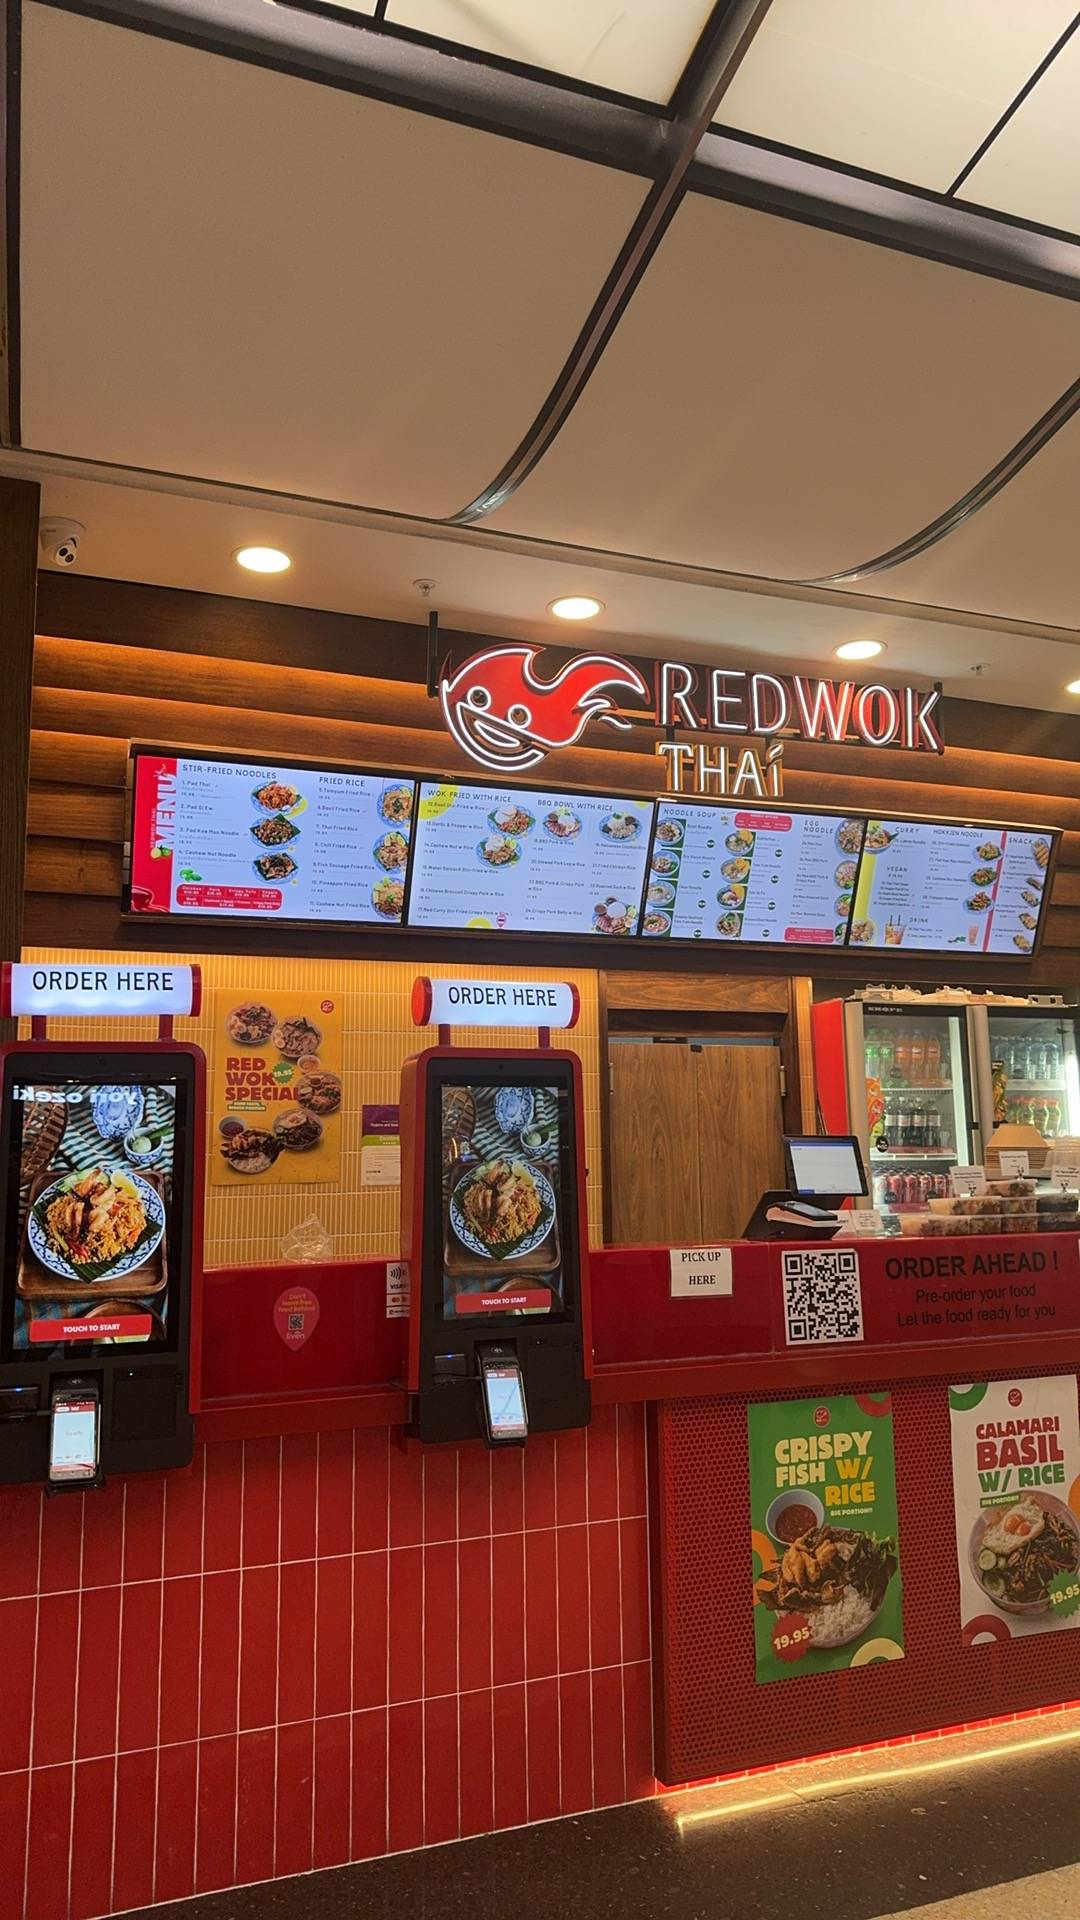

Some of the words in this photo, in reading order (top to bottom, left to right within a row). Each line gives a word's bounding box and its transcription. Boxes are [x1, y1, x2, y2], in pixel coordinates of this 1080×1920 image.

[236, 768, 276, 779] NOODLES
[319, 776, 343, 785] FRIED
[664, 808, 694, 817] NOODLE
[33, 971, 108, 990] ORDER
[118, 972, 174, 990] HERE
[448, 986, 506, 1005] ORDER
[513, 989, 557, 1006] HERE
[226, 1057, 266, 1071] RED
[225, 1072, 276, 1086] WOK
[681, 1252, 706, 1262] PICK
[708, 1251, 721, 1262] UP
[885, 1255, 966, 1280] ORDER
[971, 1251, 1047, 1276] AHEAD
[688, 1274, 715, 1285] HERE
[916, 1288, 975, 1304] Pre-order
[979, 1289, 1006, 1304] your
[1009, 1284, 1035, 1298] food
[897, 1312, 916, 1327] Let
[920, 1310, 942, 1326] the
[945, 1308, 974, 1324] food
[976, 1305, 1012, 1325] ready
[1014, 1305, 1031, 1320] for
[1034, 1304, 1056, 1321] you
[976, 1416, 1060, 1440] CALAMARI
[774, 1430, 872, 1465] CRISPY
[977, 1434, 1064, 1471] BASIL
[775, 1461, 826, 1488] FISH
[836, 1456, 874, 1481] W/
[978, 1469, 1012, 1493] W/
[1018, 1464, 1065, 1488] RICE
[825, 1481, 875, 1507] RICE
[1050, 1584, 1080, 1604] 19.95
[774, 1627, 811, 1650] 19.95
